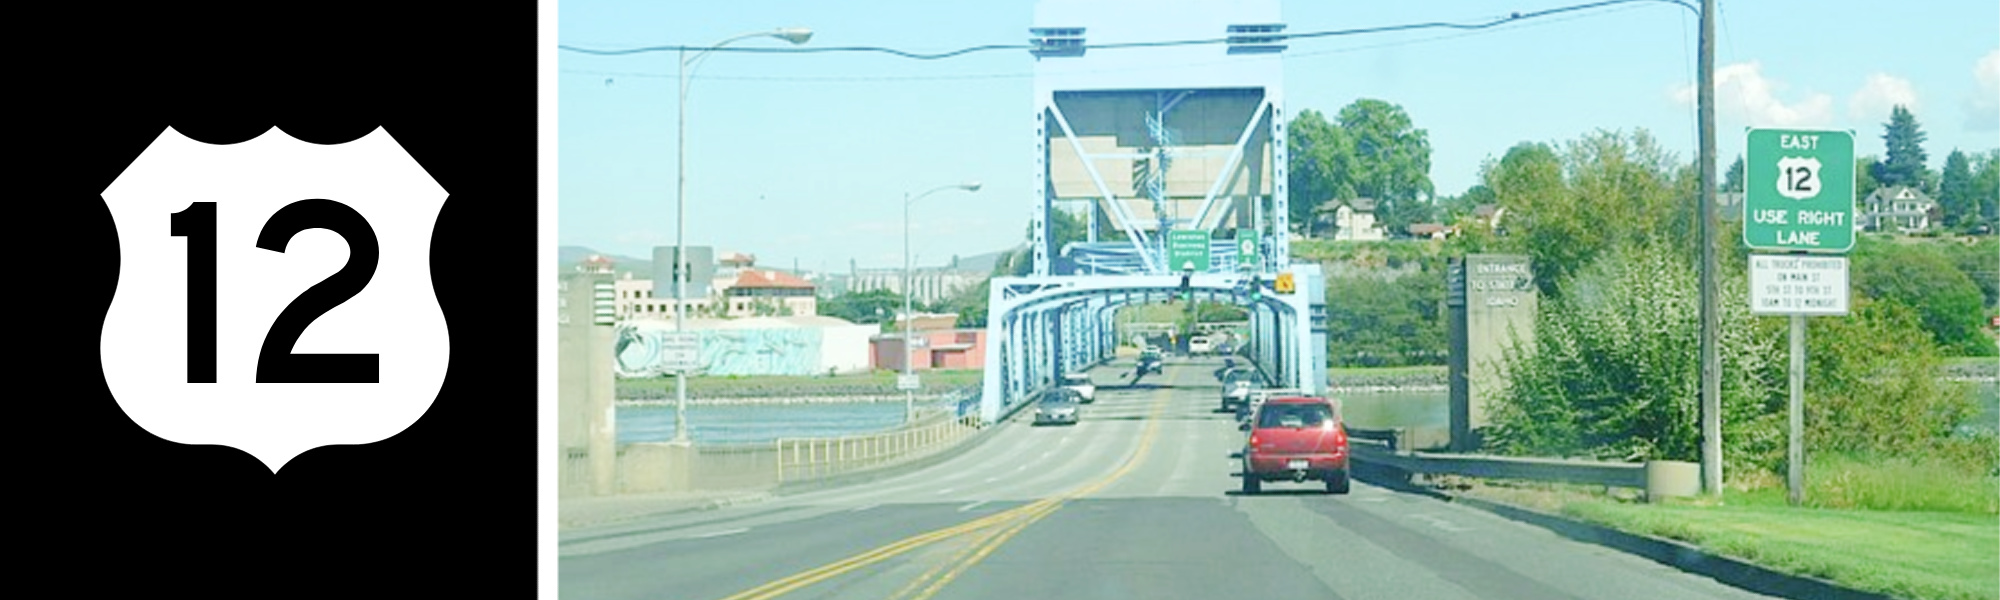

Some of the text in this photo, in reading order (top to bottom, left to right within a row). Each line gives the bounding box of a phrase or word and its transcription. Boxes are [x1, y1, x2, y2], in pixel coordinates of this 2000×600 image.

[1781, 134, 1819, 149] EAST
[1786, 166, 1812, 191] 12
[1753, 209, 1845, 226] USE RIGHT
[1776, 230, 1820, 246] LANE
[170, 198, 380, 384] 12
